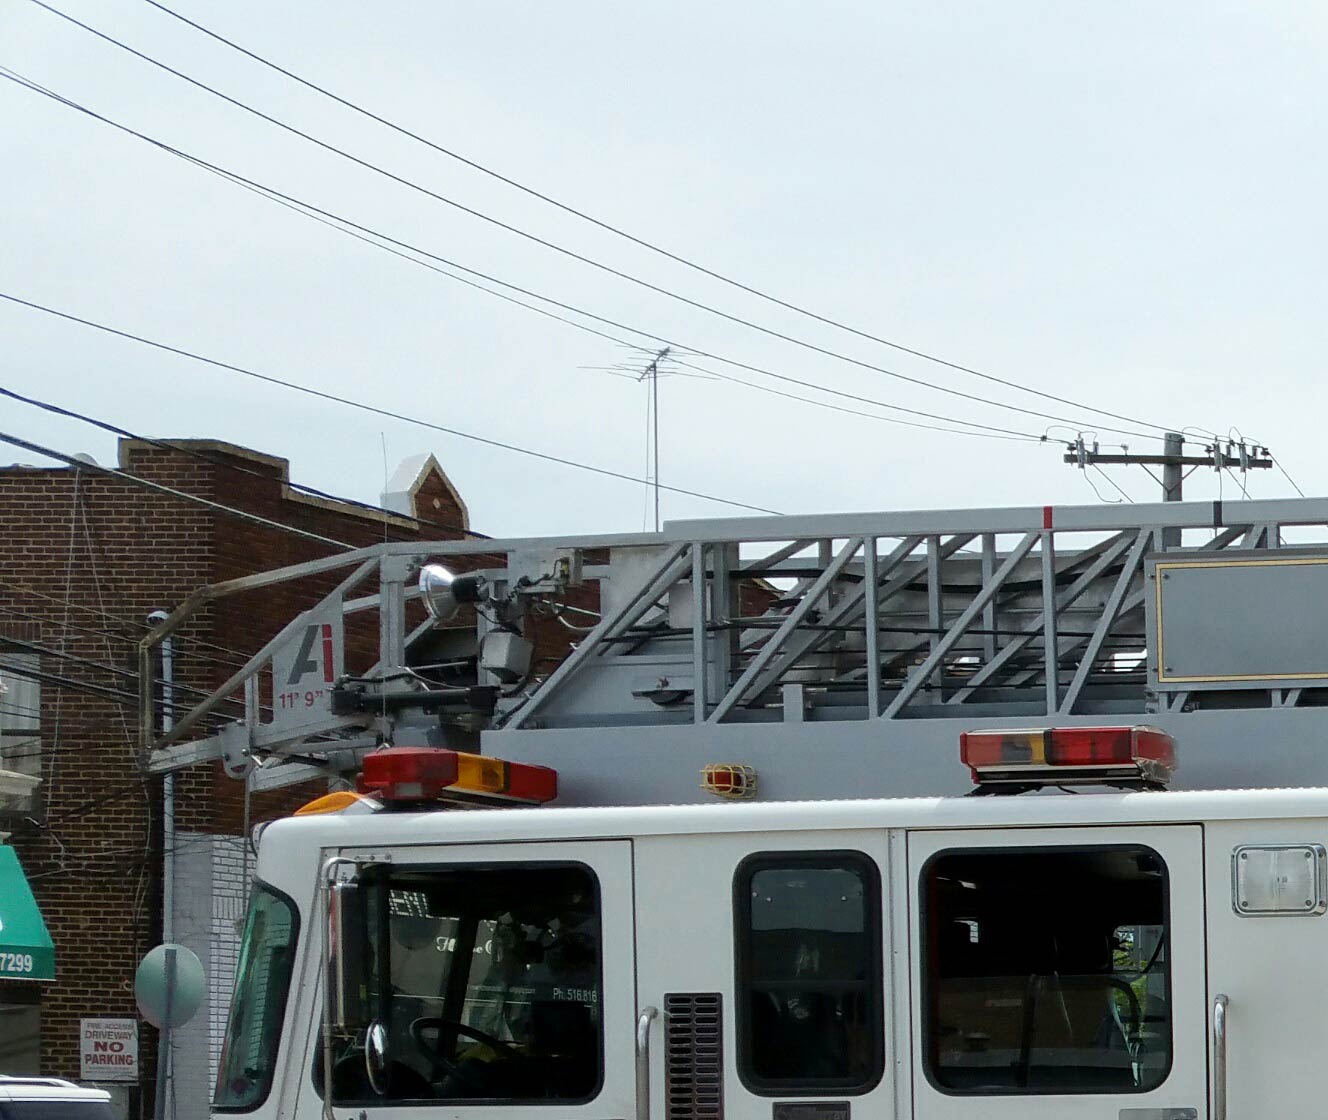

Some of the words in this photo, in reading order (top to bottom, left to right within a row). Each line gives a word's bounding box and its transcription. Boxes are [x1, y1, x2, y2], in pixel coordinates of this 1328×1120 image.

[85, 1030, 134, 1040] DRIVEWAY
[94, 1041, 124, 1053] NO
[84, 1053, 134, 1066] PARKING
